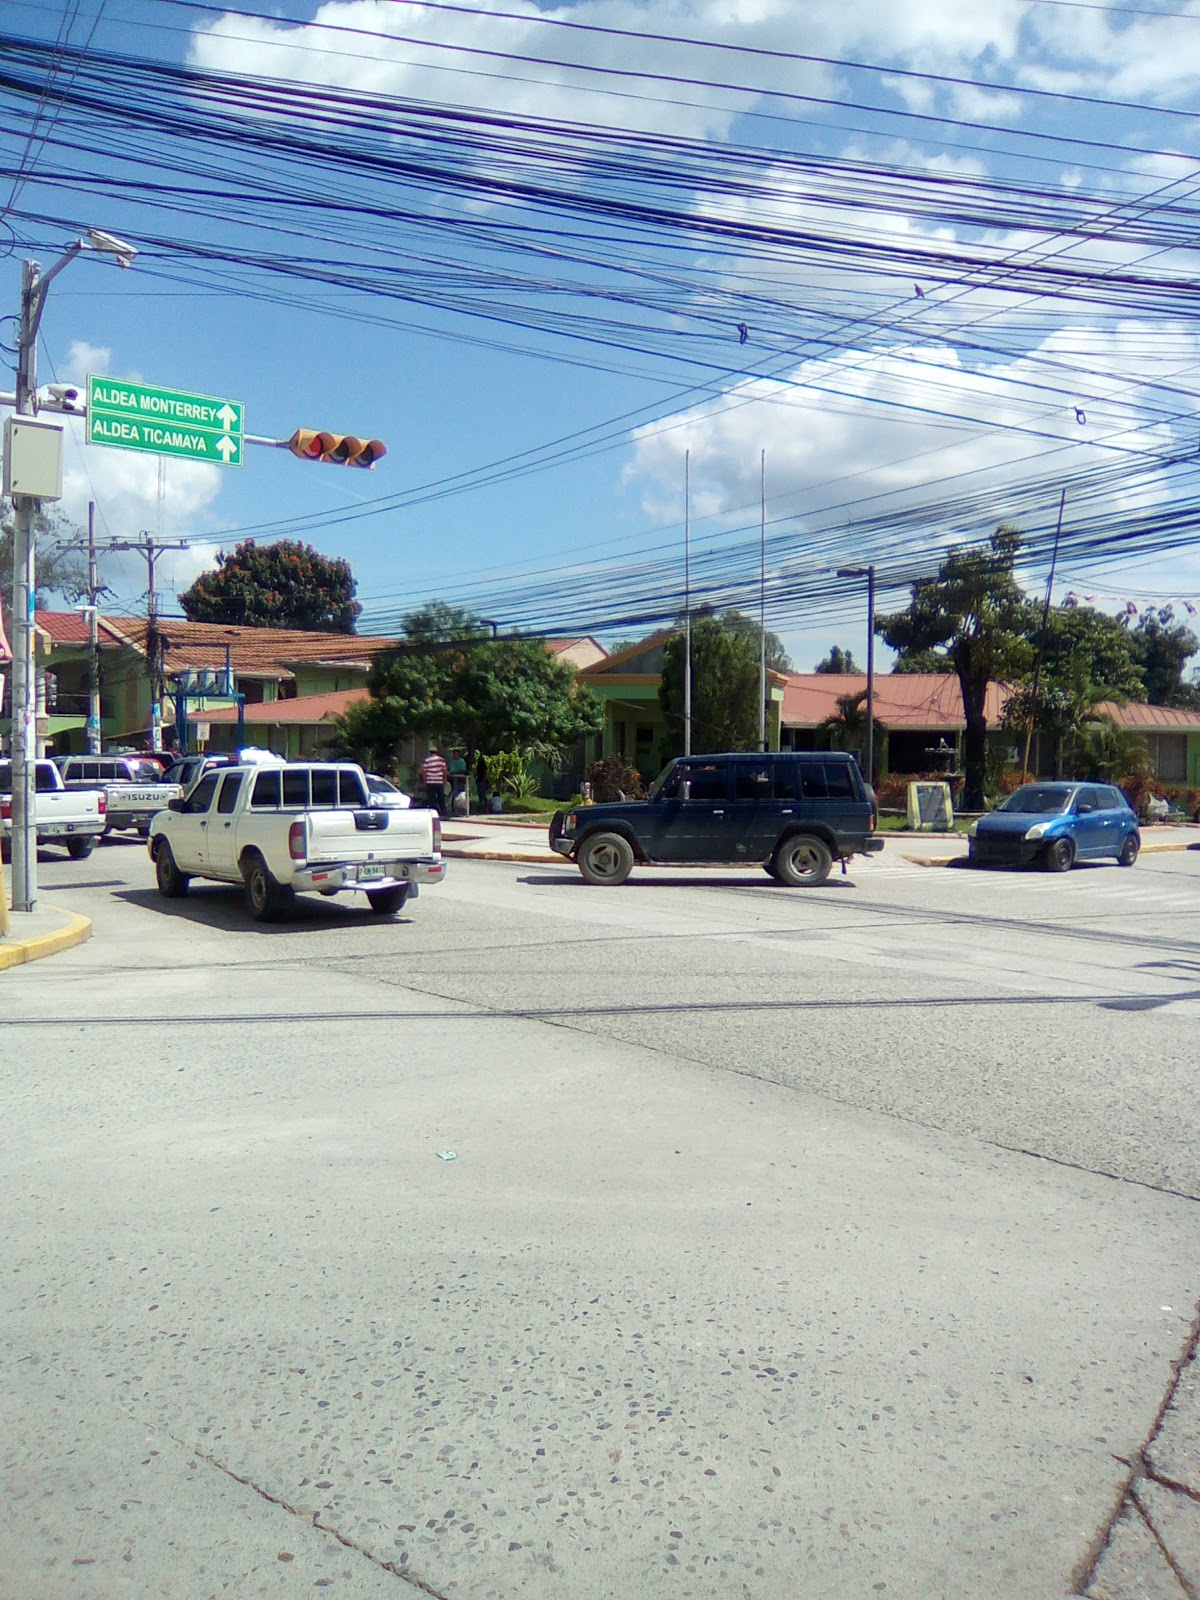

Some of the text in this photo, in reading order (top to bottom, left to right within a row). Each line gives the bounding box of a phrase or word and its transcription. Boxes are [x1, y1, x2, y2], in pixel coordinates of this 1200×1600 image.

[93, 387, 216, 422] ALDEA MONTERREY
[93, 419, 207, 452] ALDEA TICAMAYA
[128, 793, 160, 801] ISUZU
